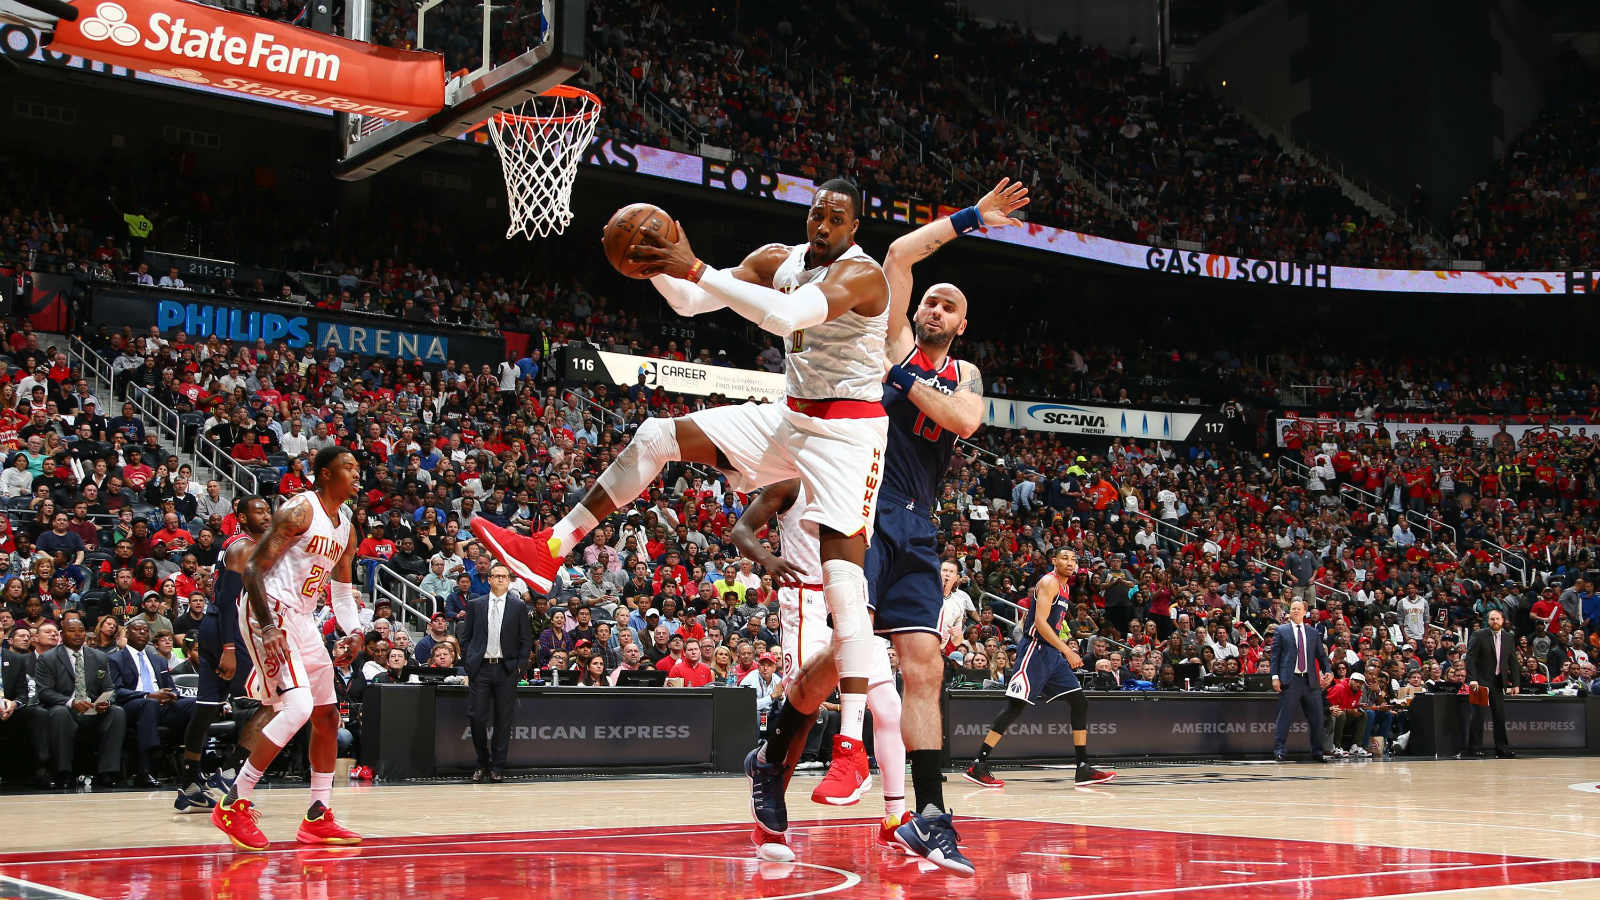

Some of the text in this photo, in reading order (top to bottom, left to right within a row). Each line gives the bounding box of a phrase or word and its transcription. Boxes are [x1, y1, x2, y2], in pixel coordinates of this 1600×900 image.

[1146, 247, 1331, 288] GAS SOUTH
[158, 300, 447, 361] PHILIPS ARENA
[572, 358, 594, 372] 116
[661, 365, 707, 381] CAREER
[1043, 412, 1105, 428] SCANA
[1081, 427, 1105, 435] ENERGY
[1205, 423, 1224, 433] 117
[861, 447, 881, 518] HAWKS
[461, 725, 690, 740] ARICAN EXPRESS
[954, 722, 1118, 735] AMECAN EXESS
[1172, 722, 1309, 733] AMERICAN EXPSS
[1529, 721, 1576, 731] EXPRESS
